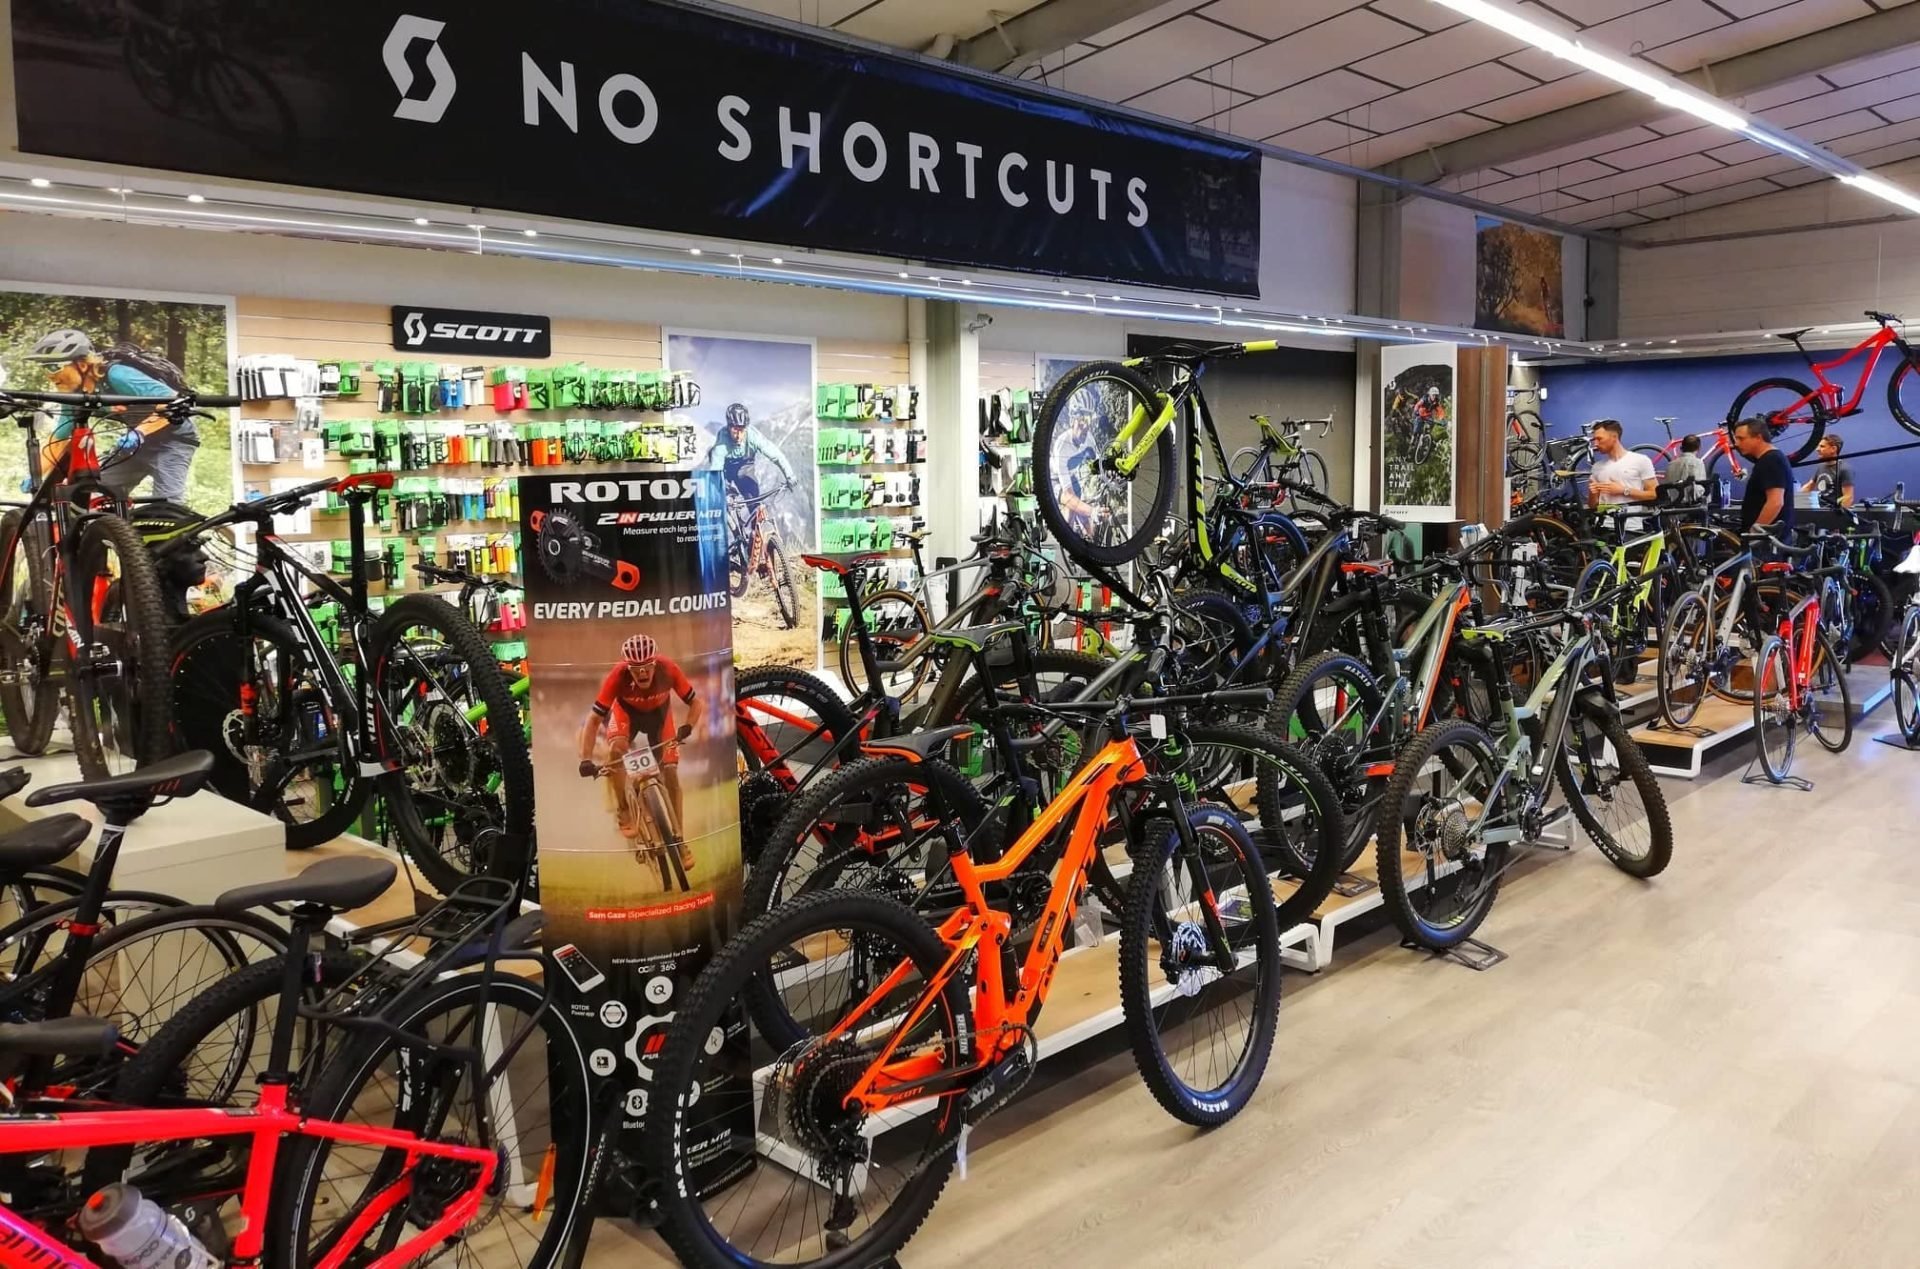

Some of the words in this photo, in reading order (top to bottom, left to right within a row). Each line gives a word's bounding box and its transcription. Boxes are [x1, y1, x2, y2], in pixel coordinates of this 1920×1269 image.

[522, 51, 659, 145] NO
[717, 94, 1150, 228] SHORTCUTS
[430, 322, 542, 343] SCOTT
[1388, 464, 1416, 472] TRAIL
[623, 527, 658, 536] Measure
[660, 526, 677, 534] each
[677, 525, 688, 534] leg
[534, 601, 594, 620] EVERY
[598, 599, 665, 619] PEDAL
[669, 591, 727, 614] COUNTS
[1344, 665, 1371, 687] MAXXIS
[629, 755, 651, 772] 30
[588, 911, 606, 919] Sam
[607, 911, 626, 919] Gaze
[673, 901, 696, 912] Racing
[1191, 1097, 1230, 1113] MAXXIS
[673, 1092, 688, 1198] MAXXIS
